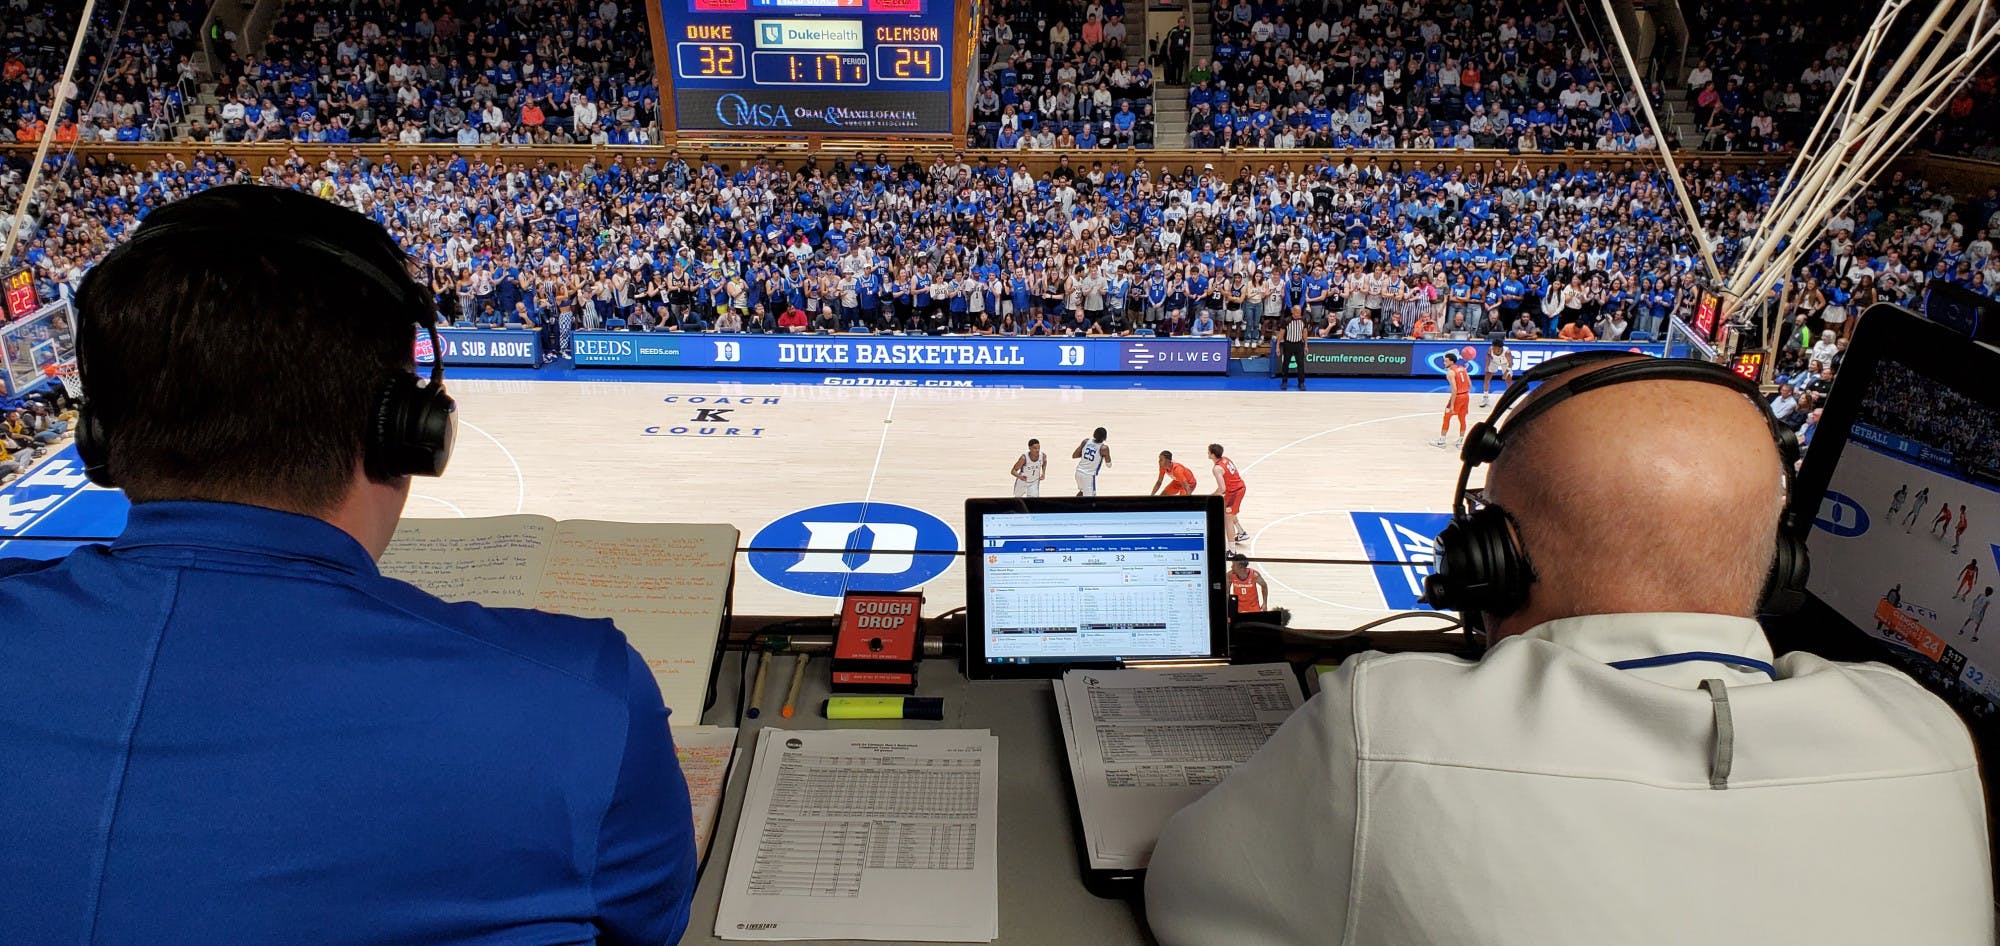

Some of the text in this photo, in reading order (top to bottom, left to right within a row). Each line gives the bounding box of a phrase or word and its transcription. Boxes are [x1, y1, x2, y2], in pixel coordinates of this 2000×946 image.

[686, 25, 733, 40] DUKE
[788, 29, 858, 41] DukeHealth
[876, 27, 938, 41] CLEMSON
[699, 46, 734, 75] 32
[789, 54, 842, 81] 1:17
[842, 57, 867, 66] PERIOD
[894, 48, 931, 77] 24
[11, 286, 32, 314] 22
[449, 341, 458, 356] A
[462, 341, 486, 357] SUB
[490, 342, 533, 357] ABOVE
[574, 340, 632, 356] REEDS
[778, 343, 1025, 366] DUKE BASKETBALL
[1158, 352, 1222, 362] DILWEG
[1306, 353, 1407, 365] Circumference Group
[664, 396, 780, 405] COACH
[690, 408, 735, 423] K
[644, 426, 766, 436] COURT
[1083, 447, 1097, 462] 25
[1062, 554, 1126, 563] 24 32
[855, 601, 913, 616] COUGH
[857, 615, 905, 630] DROP
[1922, 635, 1940, 654] 24
[1966, 666, 1984, 685] 32
